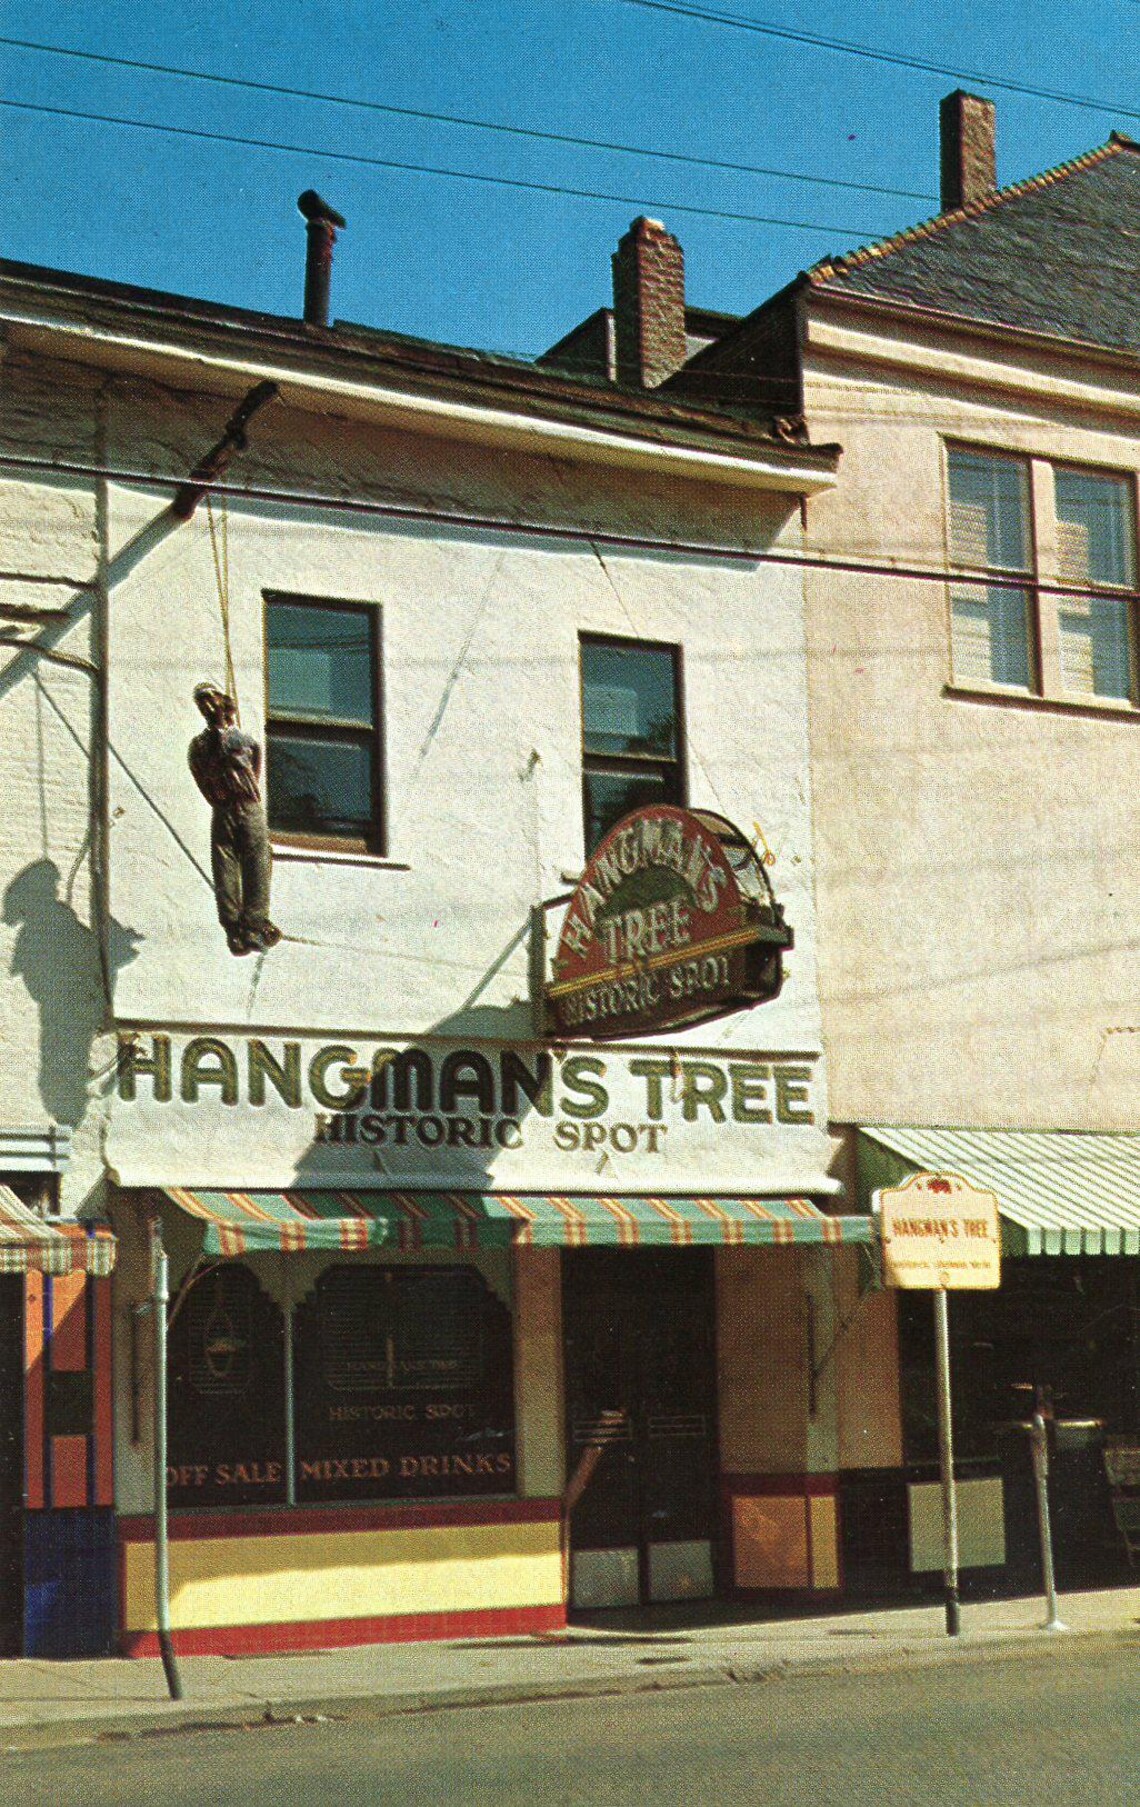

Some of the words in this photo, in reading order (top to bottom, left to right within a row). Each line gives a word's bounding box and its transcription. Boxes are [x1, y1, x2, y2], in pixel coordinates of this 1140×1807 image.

[602, 897, 691, 964] TREE
[116, 1032, 611, 1120] HANGMAN'S
[628, 1058, 815, 1126] TREE
[314, 1112, 524, 1151] HISTORIC
[553, 1120, 668, 1155] SPOT
[328, 1404, 416, 1422] HISTORIC
[425, 1402, 477, 1420] SPOT
[214, 1461, 283, 1487] SALE
[299, 1456, 390, 1482] MIXED
[399, 1450, 512, 1479] DRINKS
